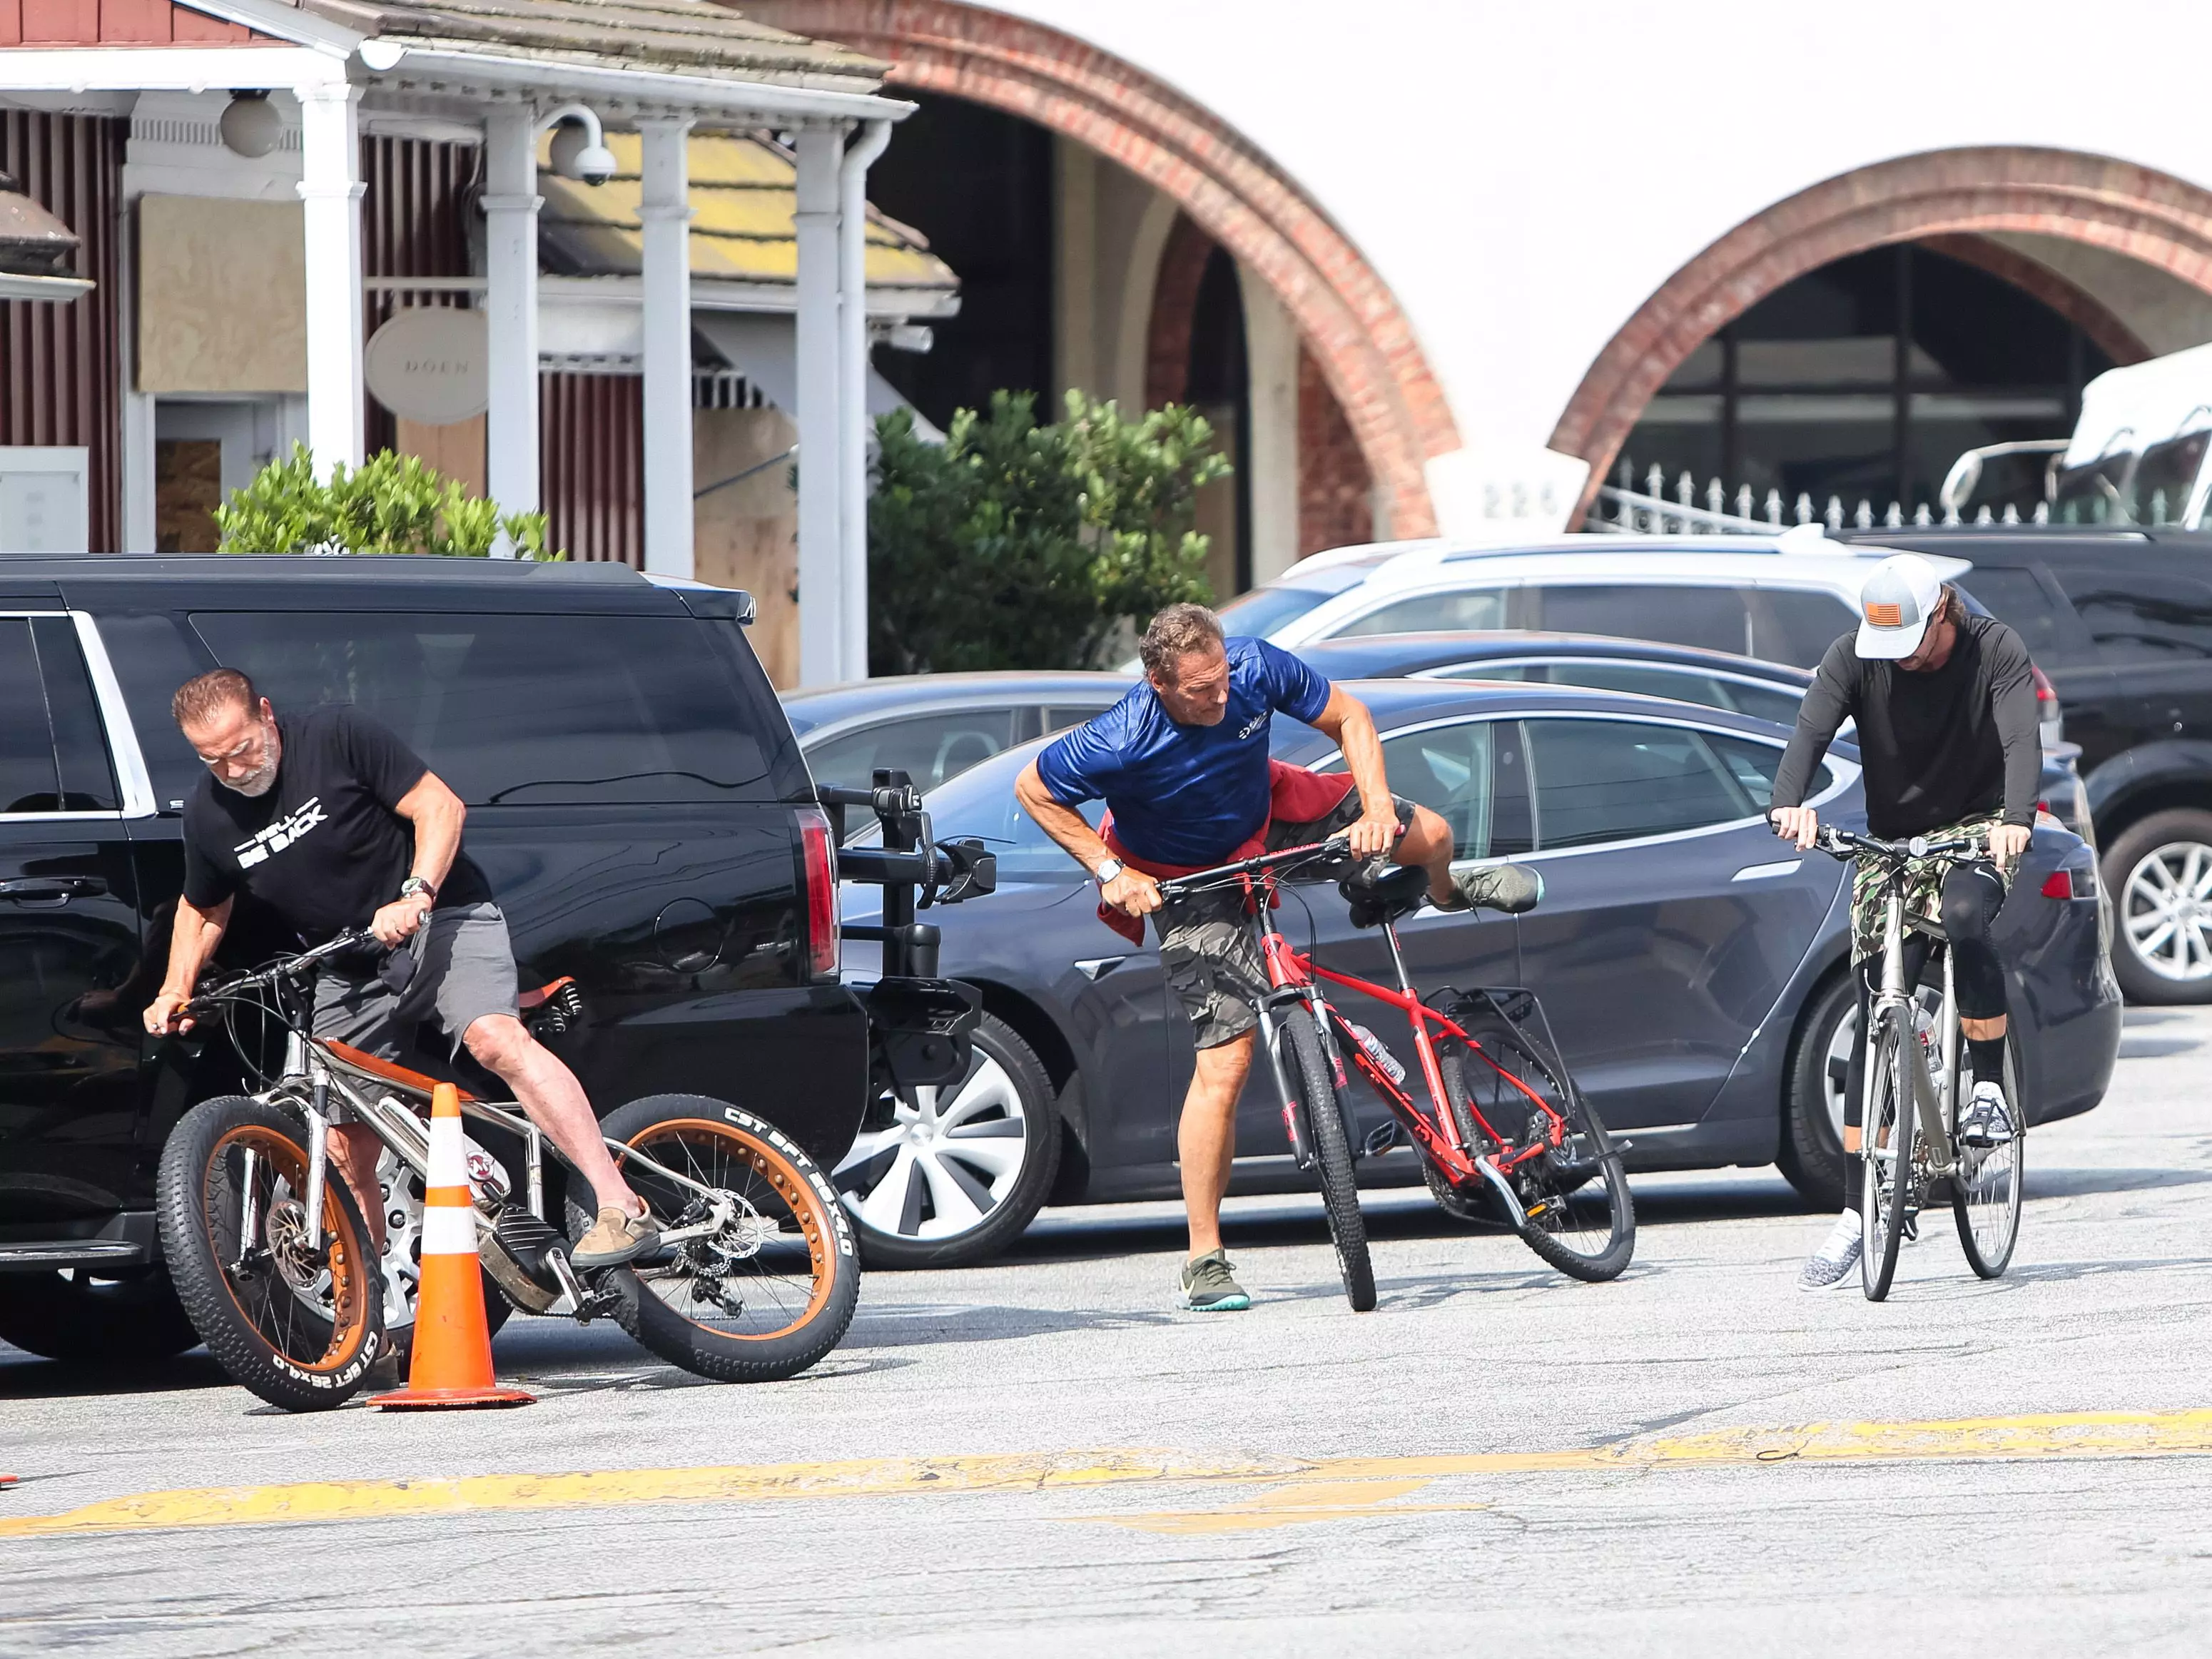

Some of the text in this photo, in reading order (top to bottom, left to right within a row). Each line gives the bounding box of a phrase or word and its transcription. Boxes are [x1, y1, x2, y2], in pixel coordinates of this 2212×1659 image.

[237, 804, 329, 869] BE BACK
[724, 1107, 768, 1133] CST
[767, 1130, 813, 1168] BFT
[360, 1331, 378, 1369] CST
